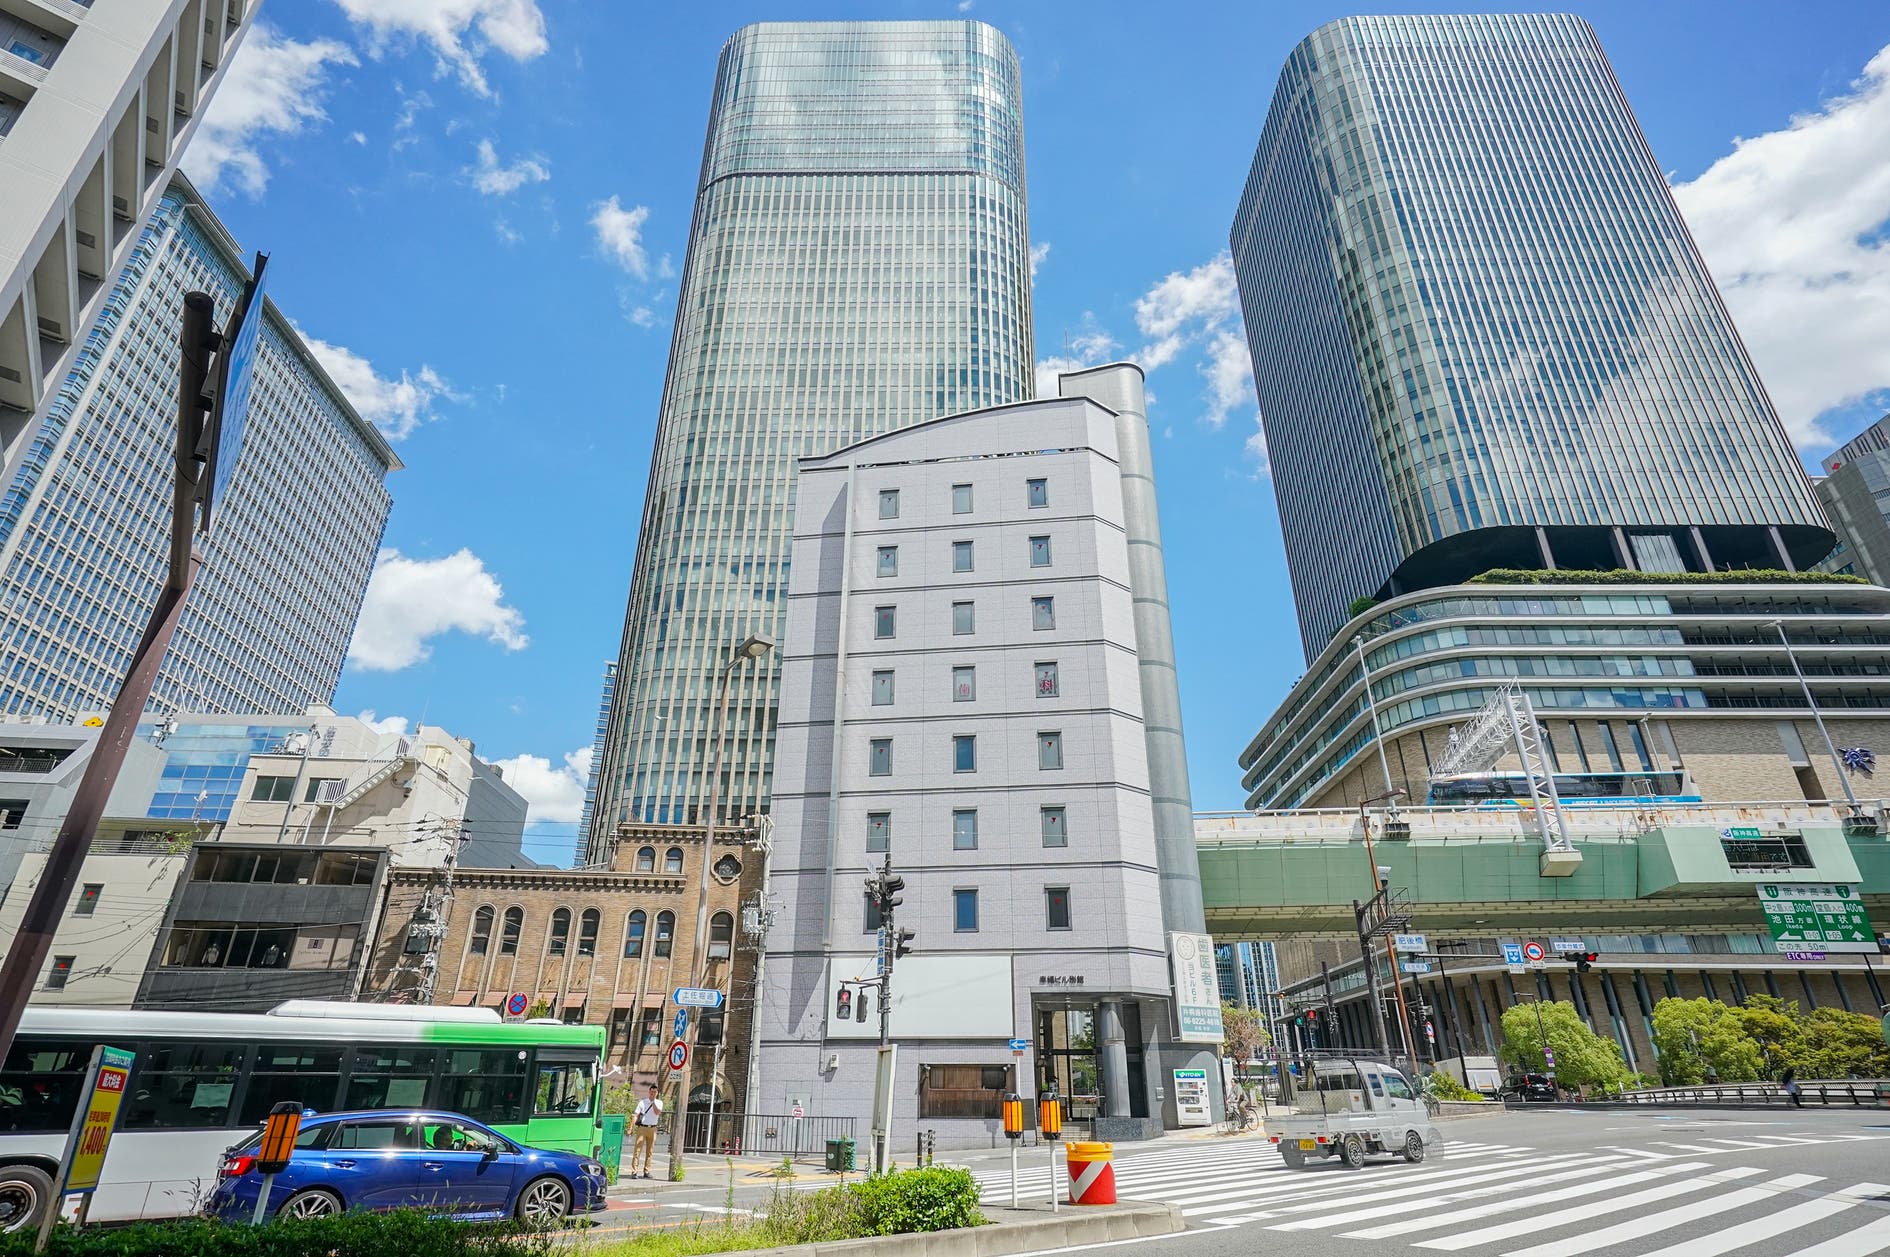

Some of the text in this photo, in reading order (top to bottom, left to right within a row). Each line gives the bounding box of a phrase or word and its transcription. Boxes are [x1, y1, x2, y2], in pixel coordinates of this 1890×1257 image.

[1040, 679, 1054, 692] 科
[1733, 829, 1759, 837] 阪神高速
[1767, 887, 1778, 897] 11
[1782, 887, 1833, 897] 阪神高速
[1794, 903, 1814, 912] 300m
[1845, 903, 1865, 912] 400m
[1771, 915, 1814, 924] 池田方面
[1824, 915, 1862, 924] 環状線
[1397, 936, 1424, 945] 肥後橋
[1778, 942, 1827, 951] この先 50m
[682, 991, 714, 1000] 土佐堀通
[102, 1072, 122, 1089] 最大料金
